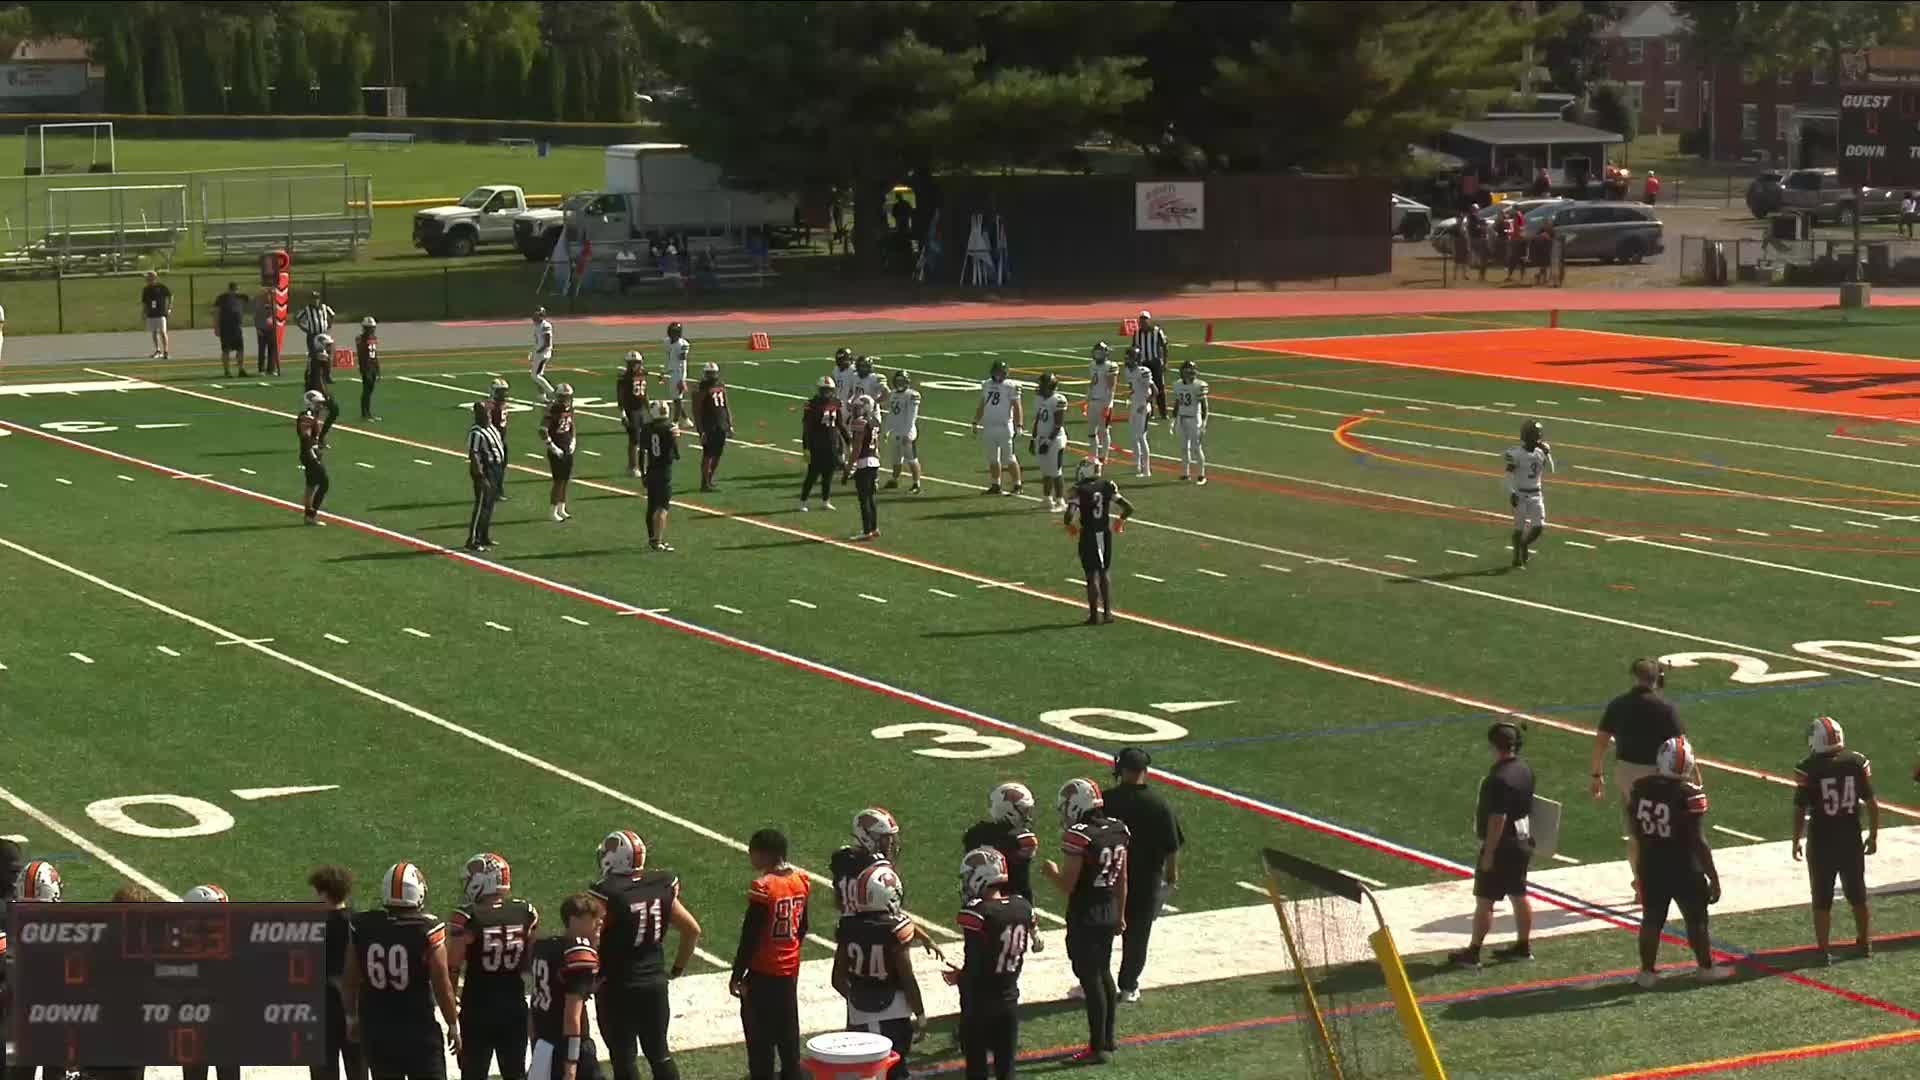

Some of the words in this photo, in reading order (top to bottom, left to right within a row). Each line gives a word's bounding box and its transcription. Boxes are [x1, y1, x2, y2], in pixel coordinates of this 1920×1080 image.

[1842, 95, 1891, 108] GUEST
[1845, 144, 1886, 158] DOWN
[986, 391, 1001, 406] 78
[651, 435, 661, 457] 8
[1092, 491, 1104, 519] 3
[1820, 775, 1857, 816] 54
[1636, 797, 1671, 838] 53
[629, 897, 662, 948] 71
[482, 924, 525, 973] 55
[366, 943, 410, 991] 69
